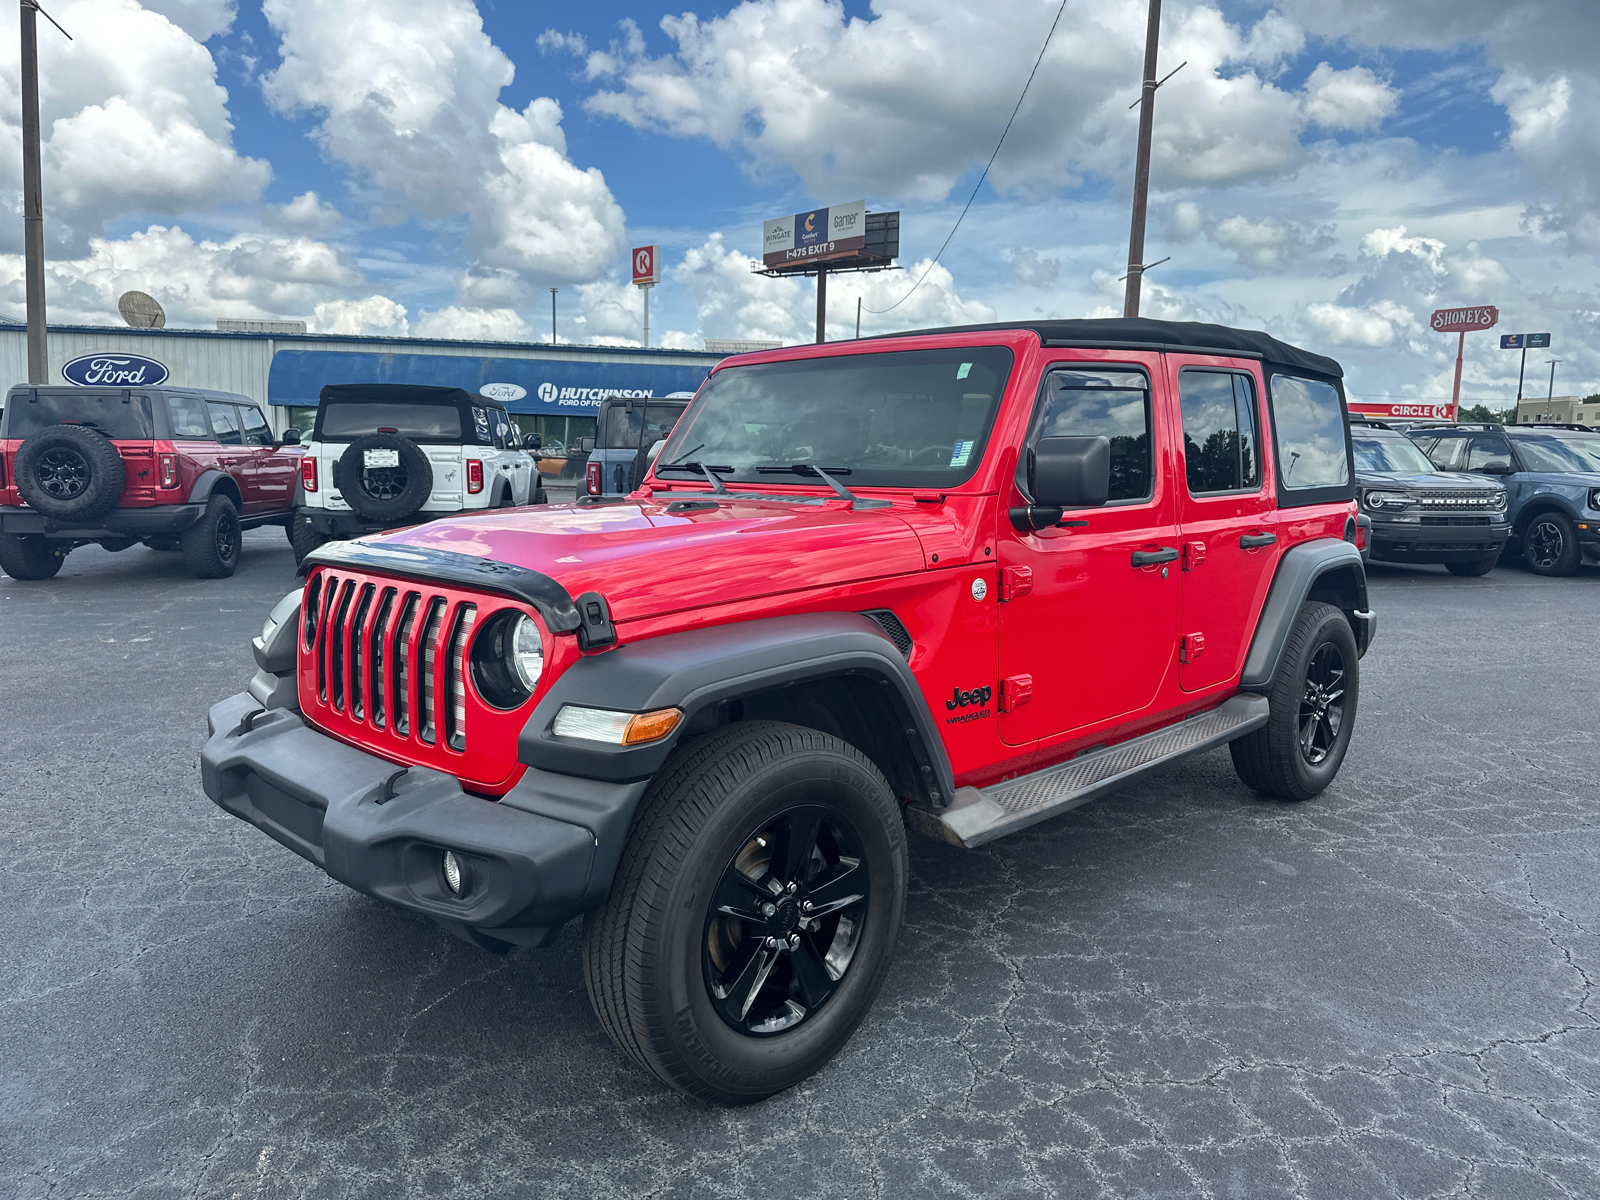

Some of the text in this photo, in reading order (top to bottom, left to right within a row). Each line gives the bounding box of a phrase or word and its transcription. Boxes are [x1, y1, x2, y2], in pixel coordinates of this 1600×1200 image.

[834, 212, 859, 228] Garner
[765, 230, 791, 242] WINGATE
[802, 232, 818, 240] Comfort
[786, 241, 835, 259] I-475 EXIT 9
[1433, 308, 1492, 328] SHONEY'S
[85, 359, 146, 384] Ford
[489, 386, 516, 397] Ford
[559, 387, 653, 400] HUTCHINSON
[1391, 405, 1446, 419] CIRCLE K
[946, 685, 991, 710] Jeep
[946, 709, 990, 724] WRANGLER
